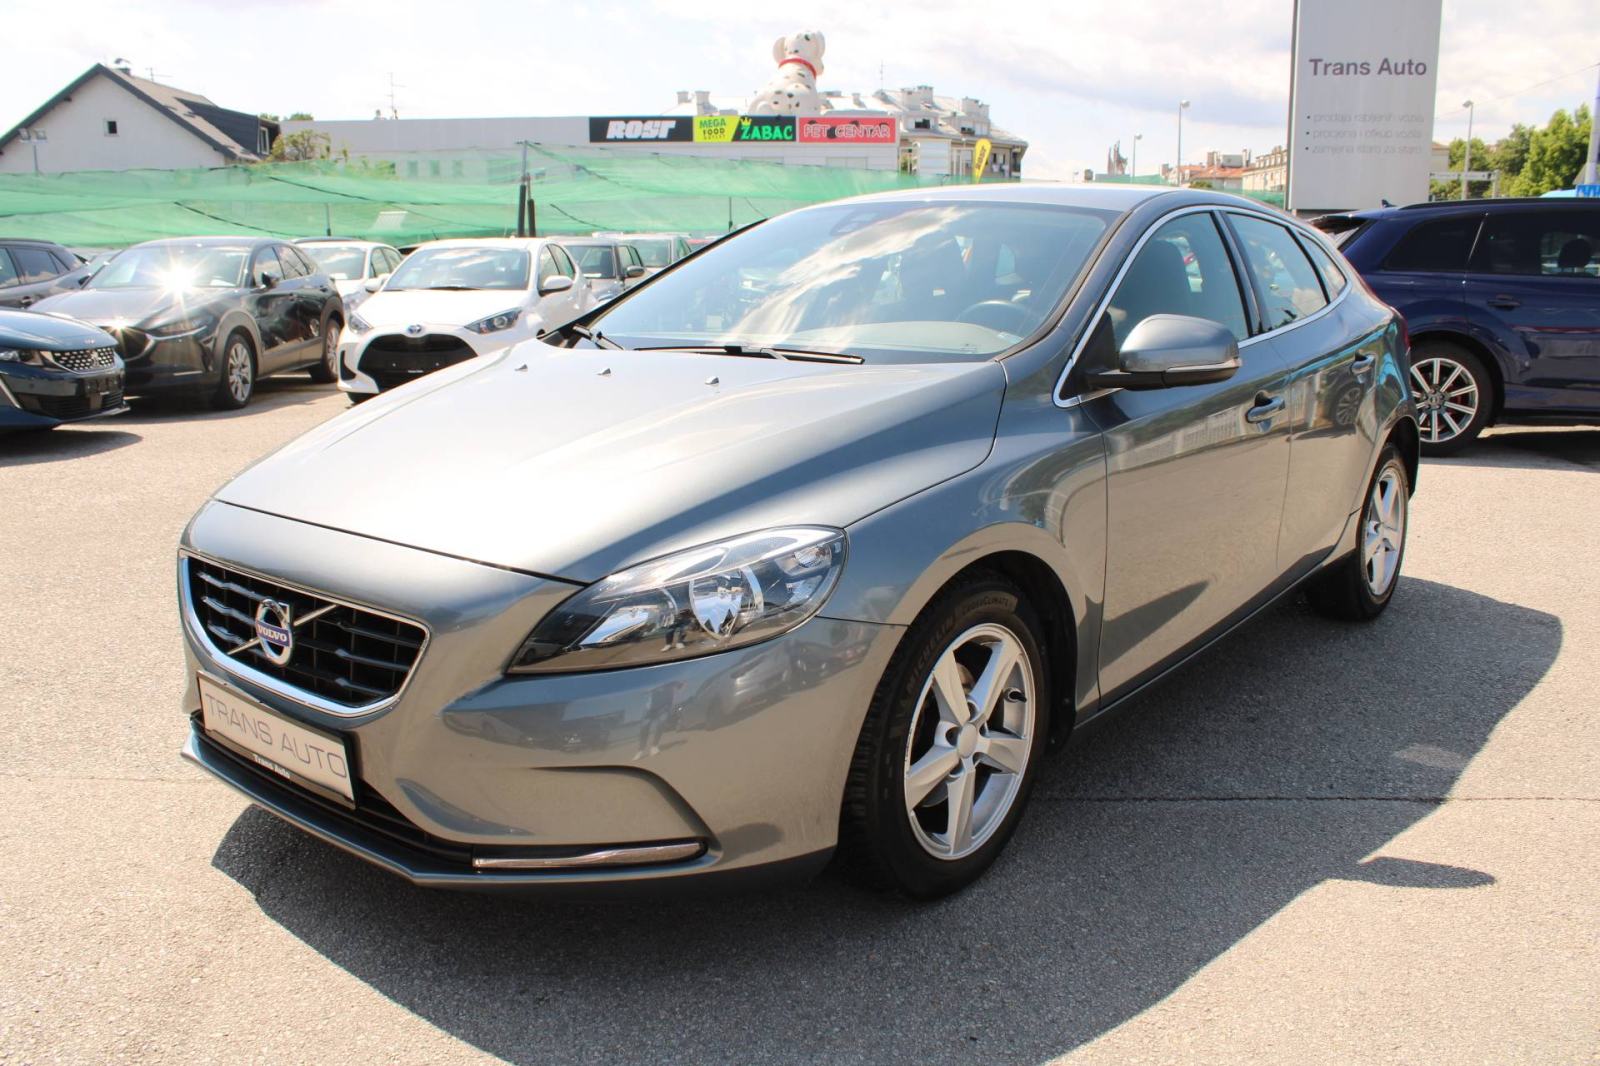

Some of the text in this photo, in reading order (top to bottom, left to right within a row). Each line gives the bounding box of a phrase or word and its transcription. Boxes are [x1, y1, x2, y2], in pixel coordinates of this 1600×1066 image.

[1308, 58, 1427, 76] Trans Auto
[700, 118, 727, 128] MEGA
[804, 124, 890, 138] PET CENTAR
[703, 128, 726, 136] FOOD
[257, 625, 288, 643] VOLVO
[205, 693, 347, 779] TRANS AUTO
